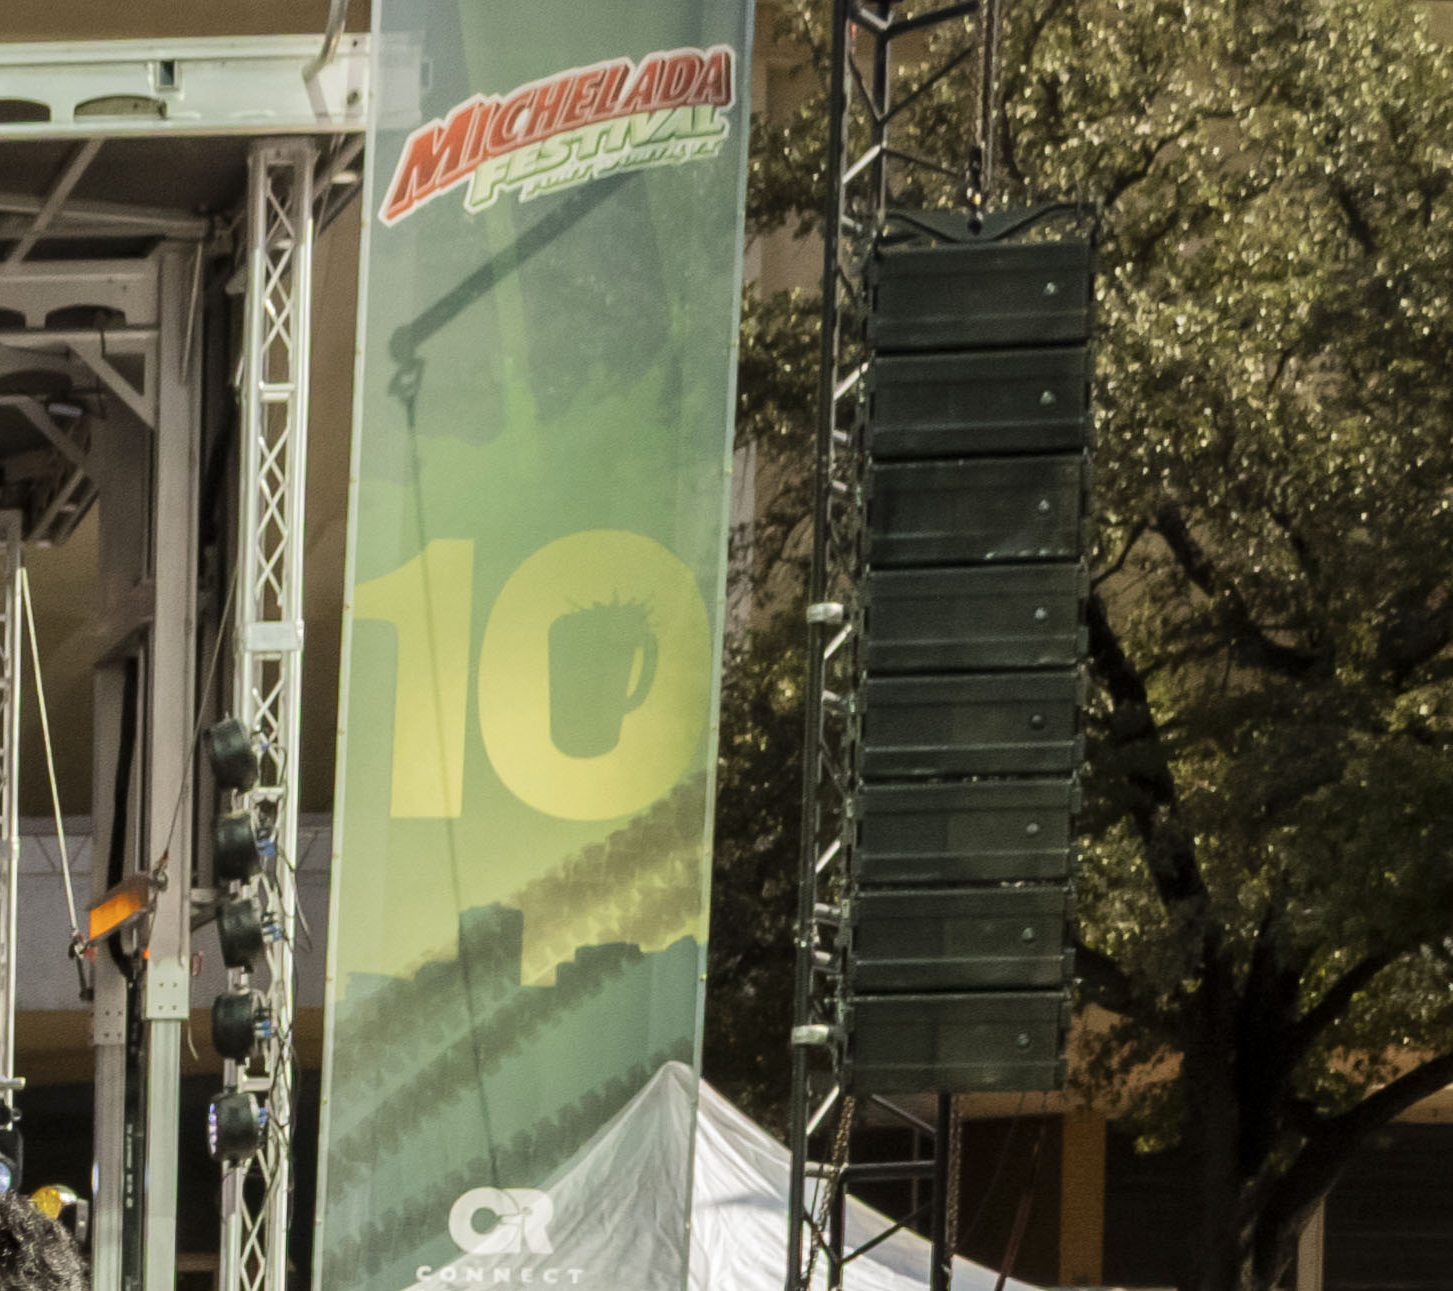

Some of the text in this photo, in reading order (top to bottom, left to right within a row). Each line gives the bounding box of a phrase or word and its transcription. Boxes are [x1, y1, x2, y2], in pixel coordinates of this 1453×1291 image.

[383, 50, 733, 222] MICHELADA
[470, 107, 727, 207] FESTIVAL
[353, 529, 714, 822] 10
[448, 1186, 554, 1255] CR
[415, 1265, 584, 1285] CONNECT
